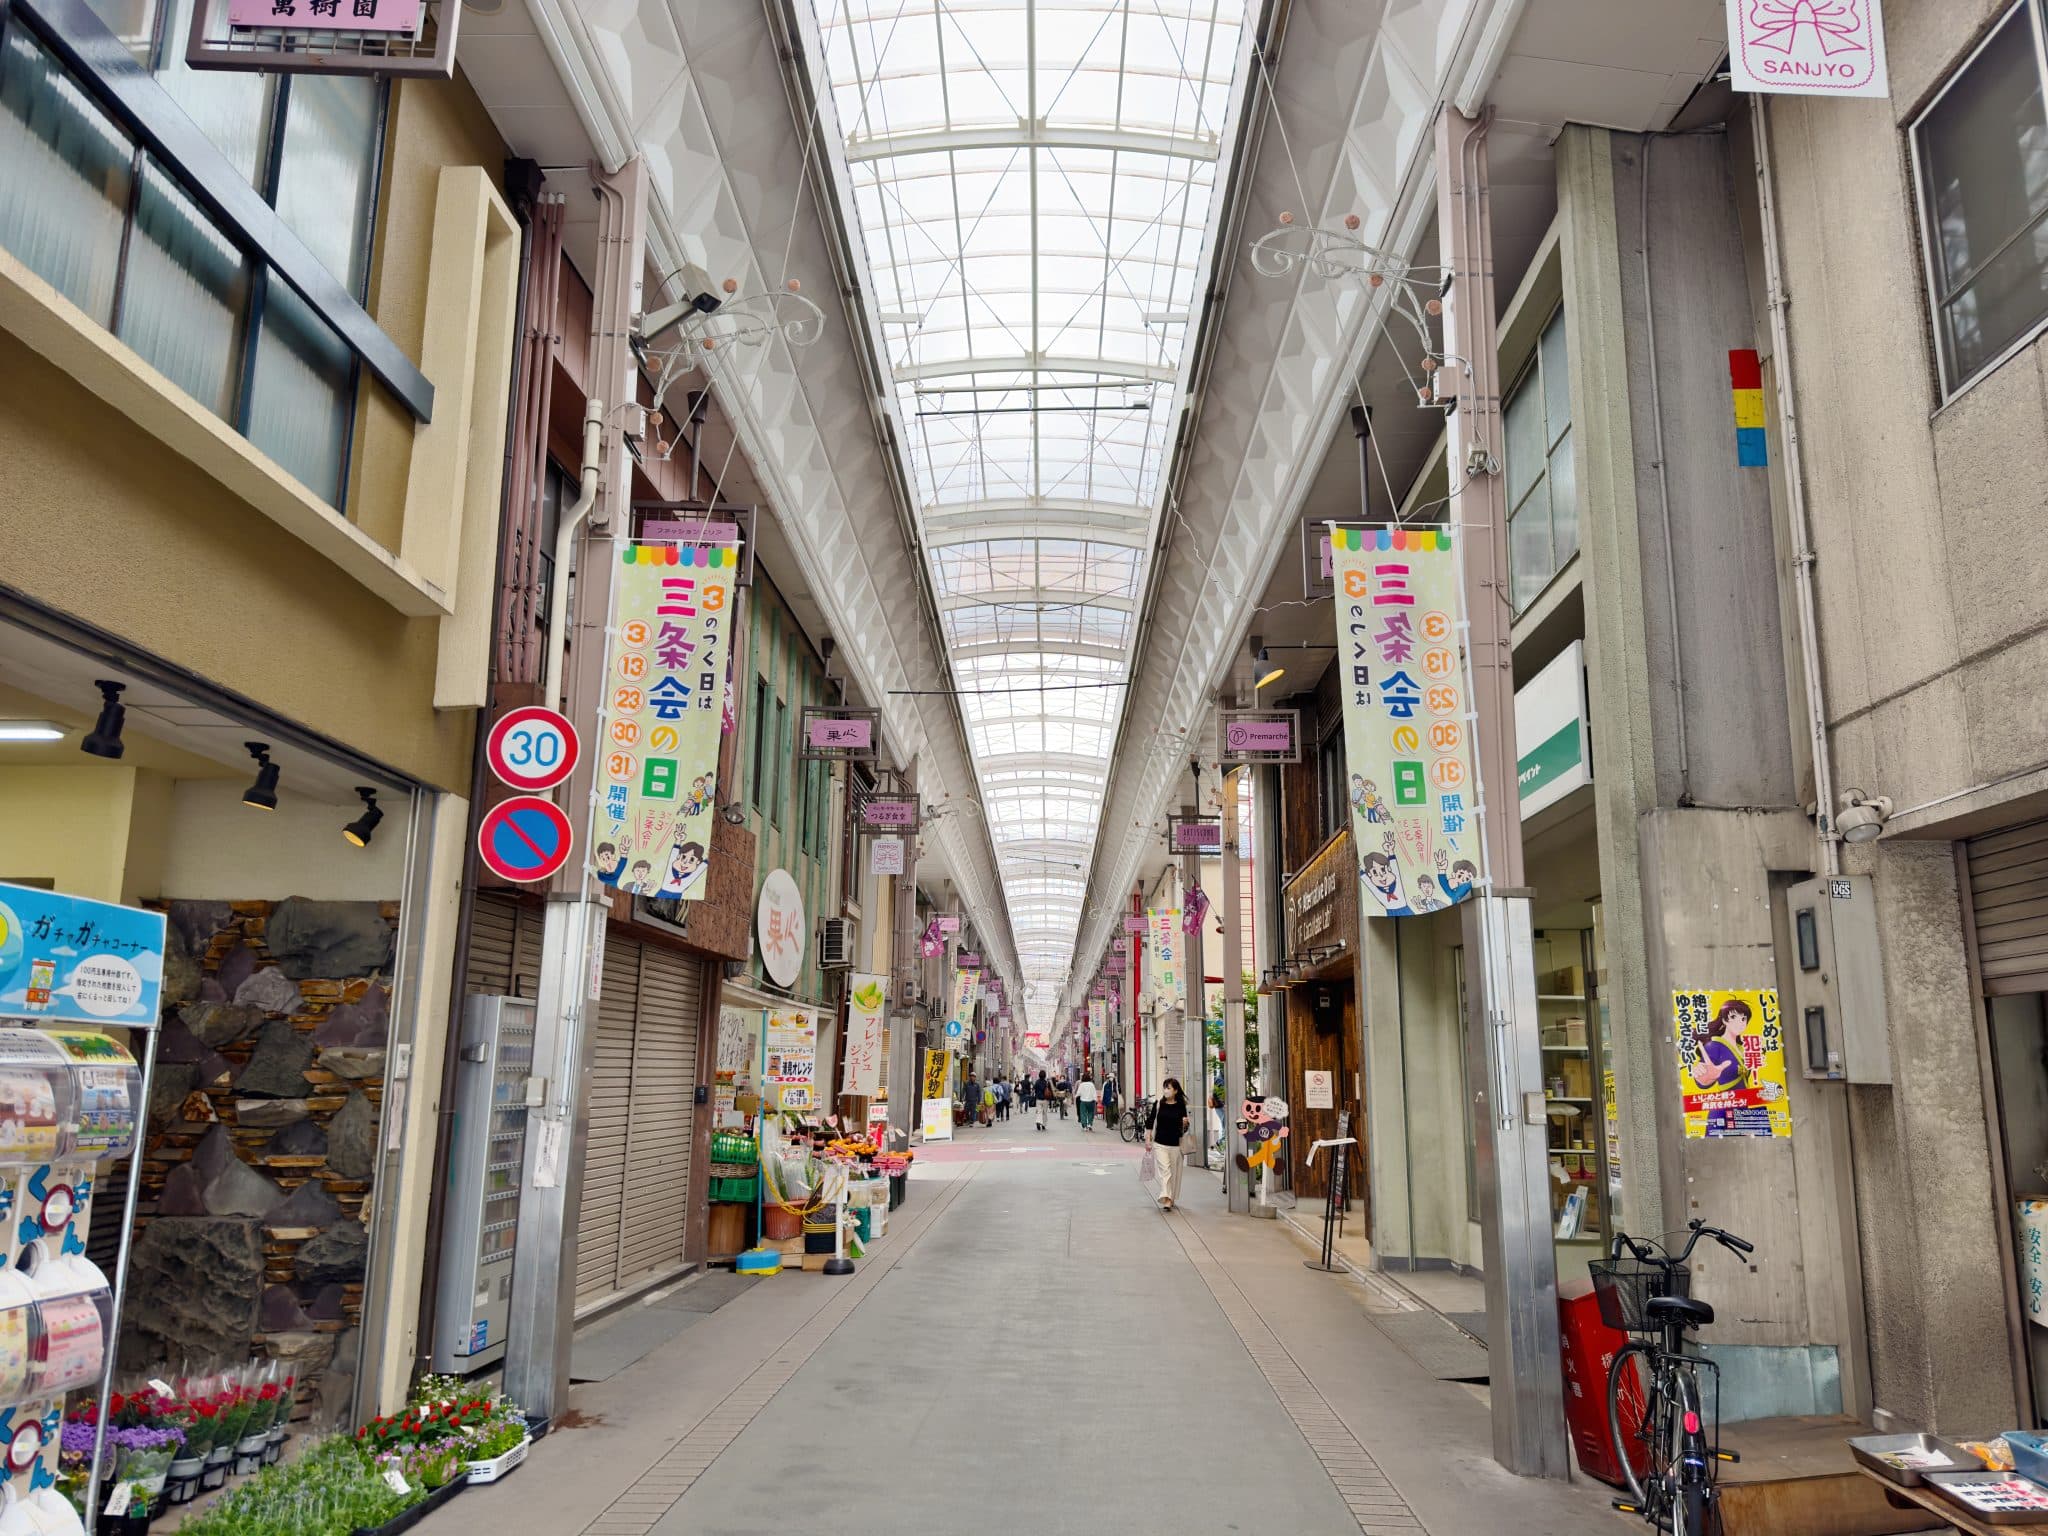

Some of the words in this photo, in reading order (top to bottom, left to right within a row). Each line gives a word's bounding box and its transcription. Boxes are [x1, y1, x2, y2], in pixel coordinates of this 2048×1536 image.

[1763, 59, 1855, 78] SANJYO
[698, 585, 726, 710] 3のつく日は
[642, 578, 697, 800] 三条会の日
[509, 730, 559, 767] 30
[1518, 763, 1543, 787] ペイント
[32, 914, 149, 951] ガチャガチャコーナー
[1692, 994, 1709, 1033] 絶対に
[1759, 994, 1779, 1051] いじめは
[862, 1017, 876, 1071] フレッシュ
[849, 1045, 861, 1091] ジュース
[2028, 1227, 2042, 1314] 安全・安心
